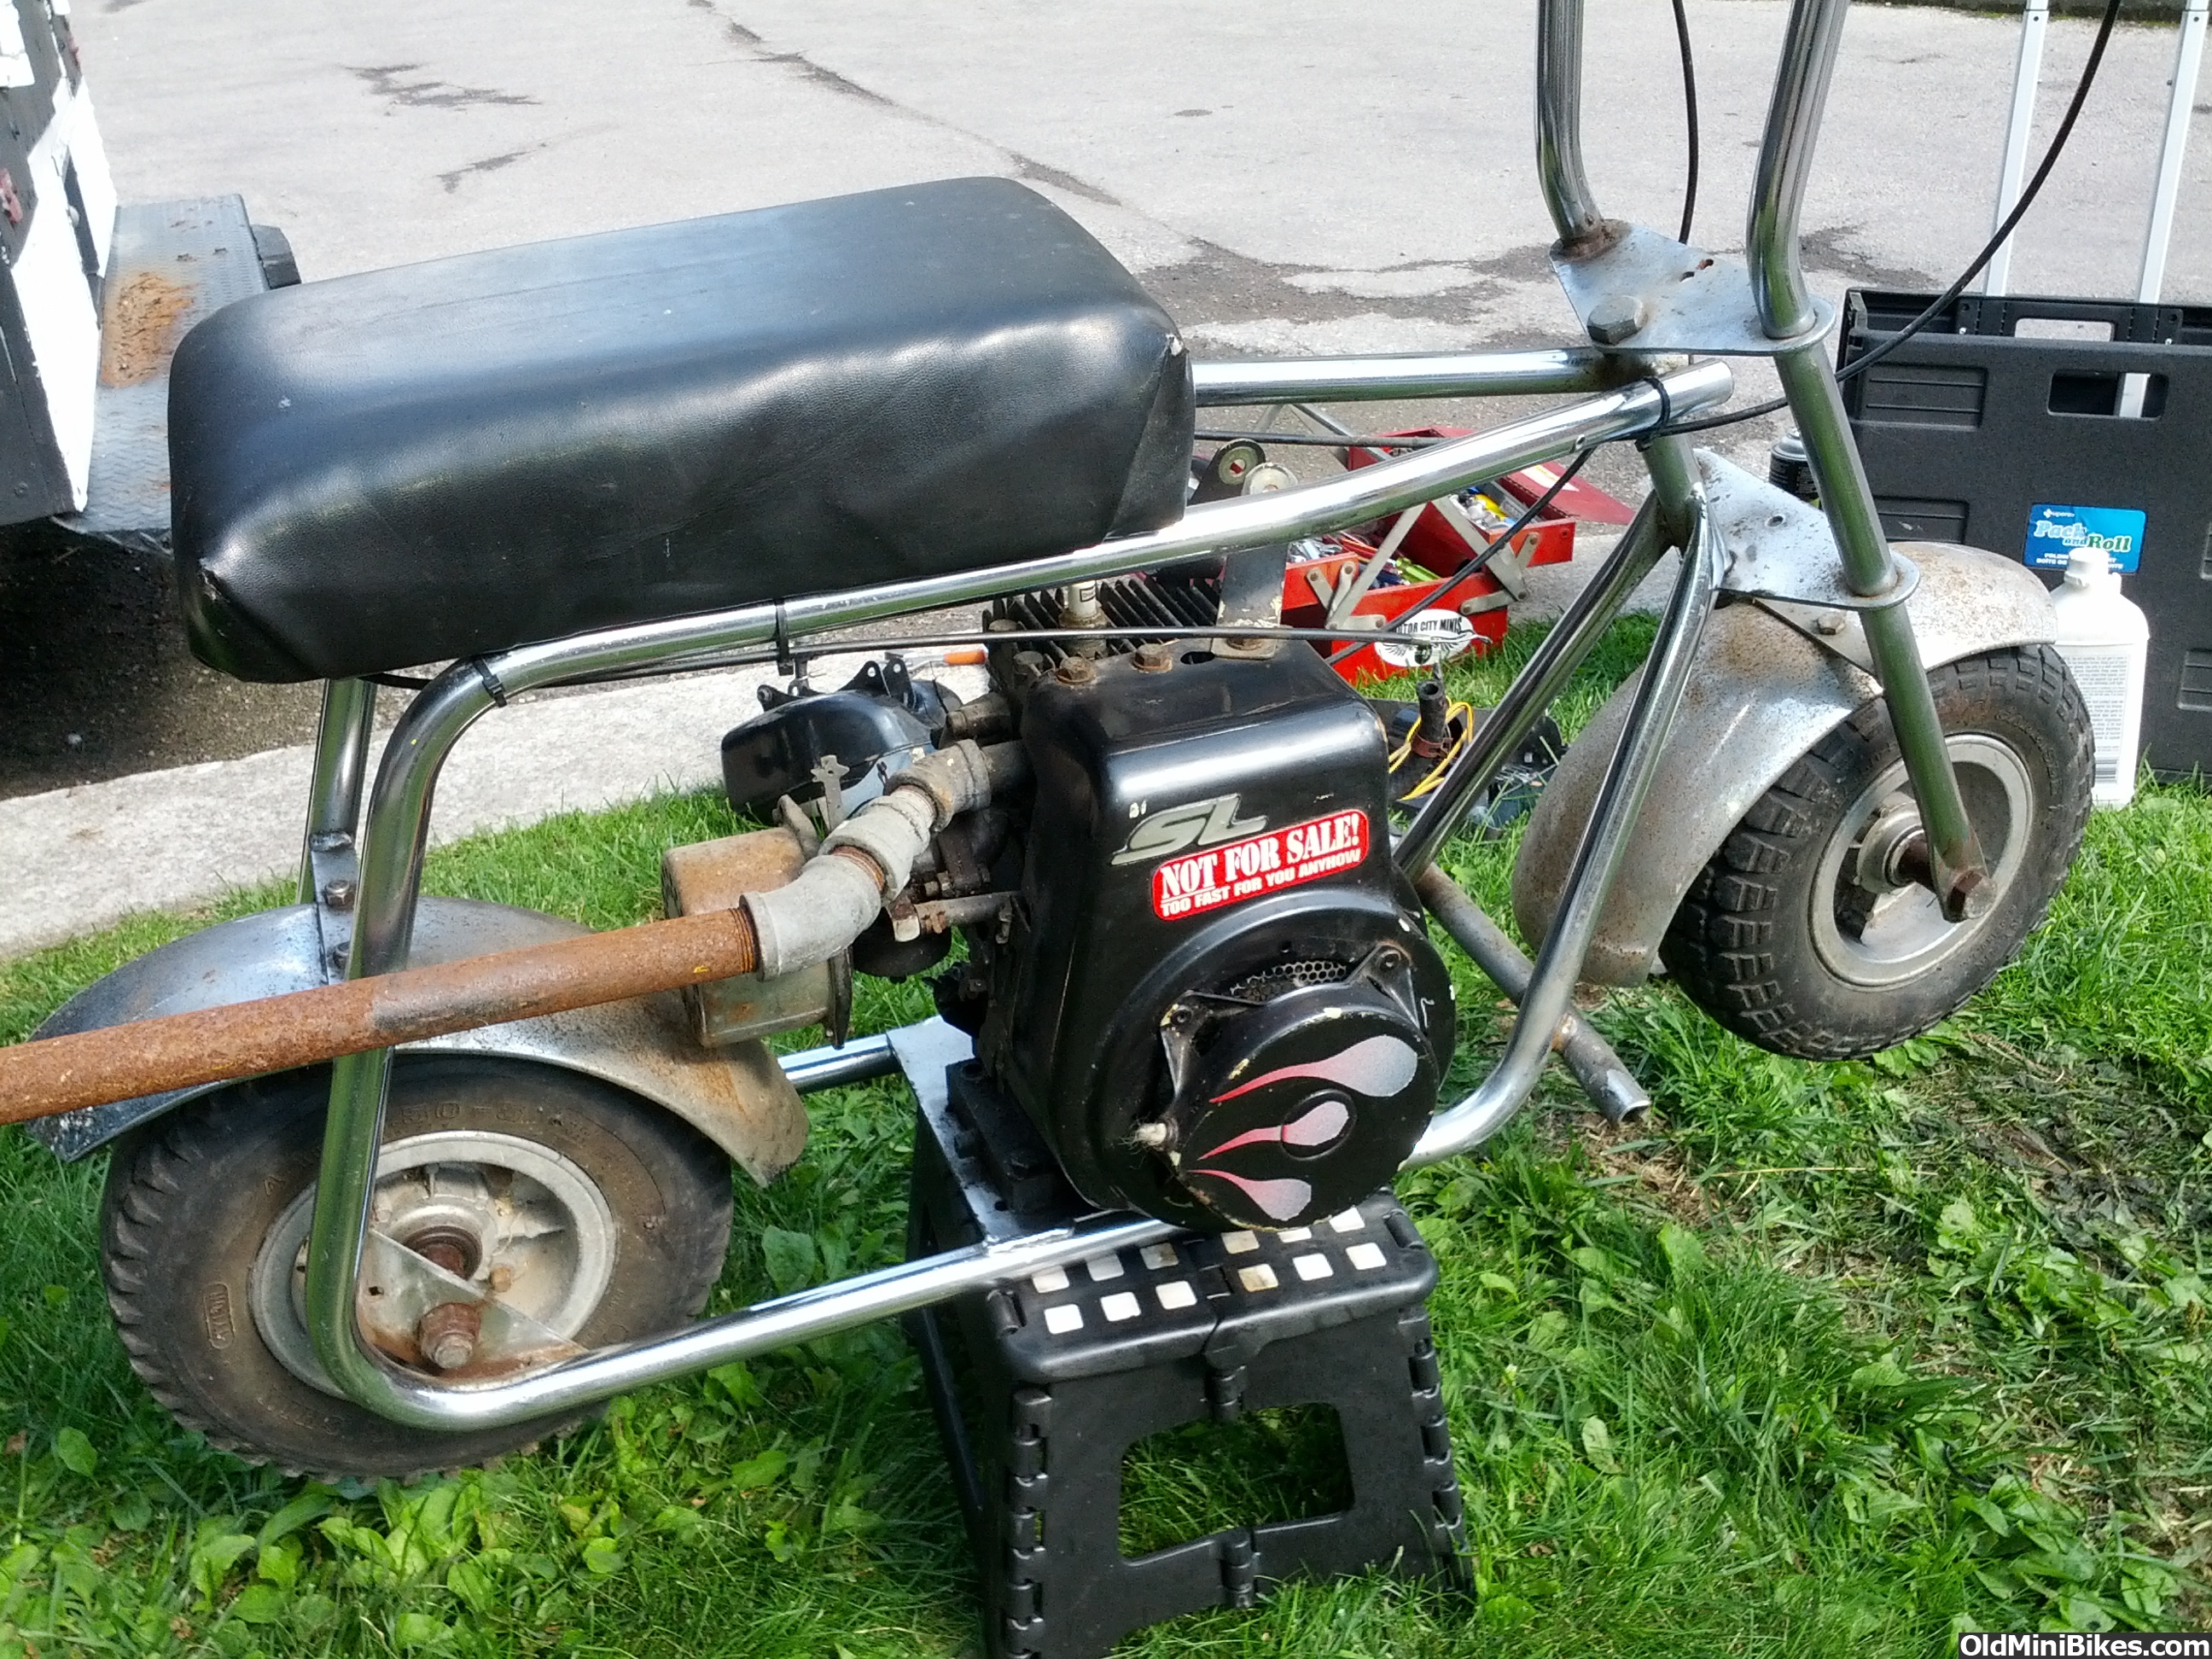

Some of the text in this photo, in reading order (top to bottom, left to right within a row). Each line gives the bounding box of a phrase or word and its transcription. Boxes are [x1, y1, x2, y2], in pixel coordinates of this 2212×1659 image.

[2034, 521, 2087, 539] Pack
[2063, 533, 2133, 553] and Roll
[1420, 620, 1438, 632] CITY
[1440, 616, 1462, 634] MINIS
[1111, 793, 1268, 865] SL
[1160, 812, 1360, 899] NOT FOR SALE!
[1161, 848, 1361, 917] TOO FAST FOR YOU ANYHOW
